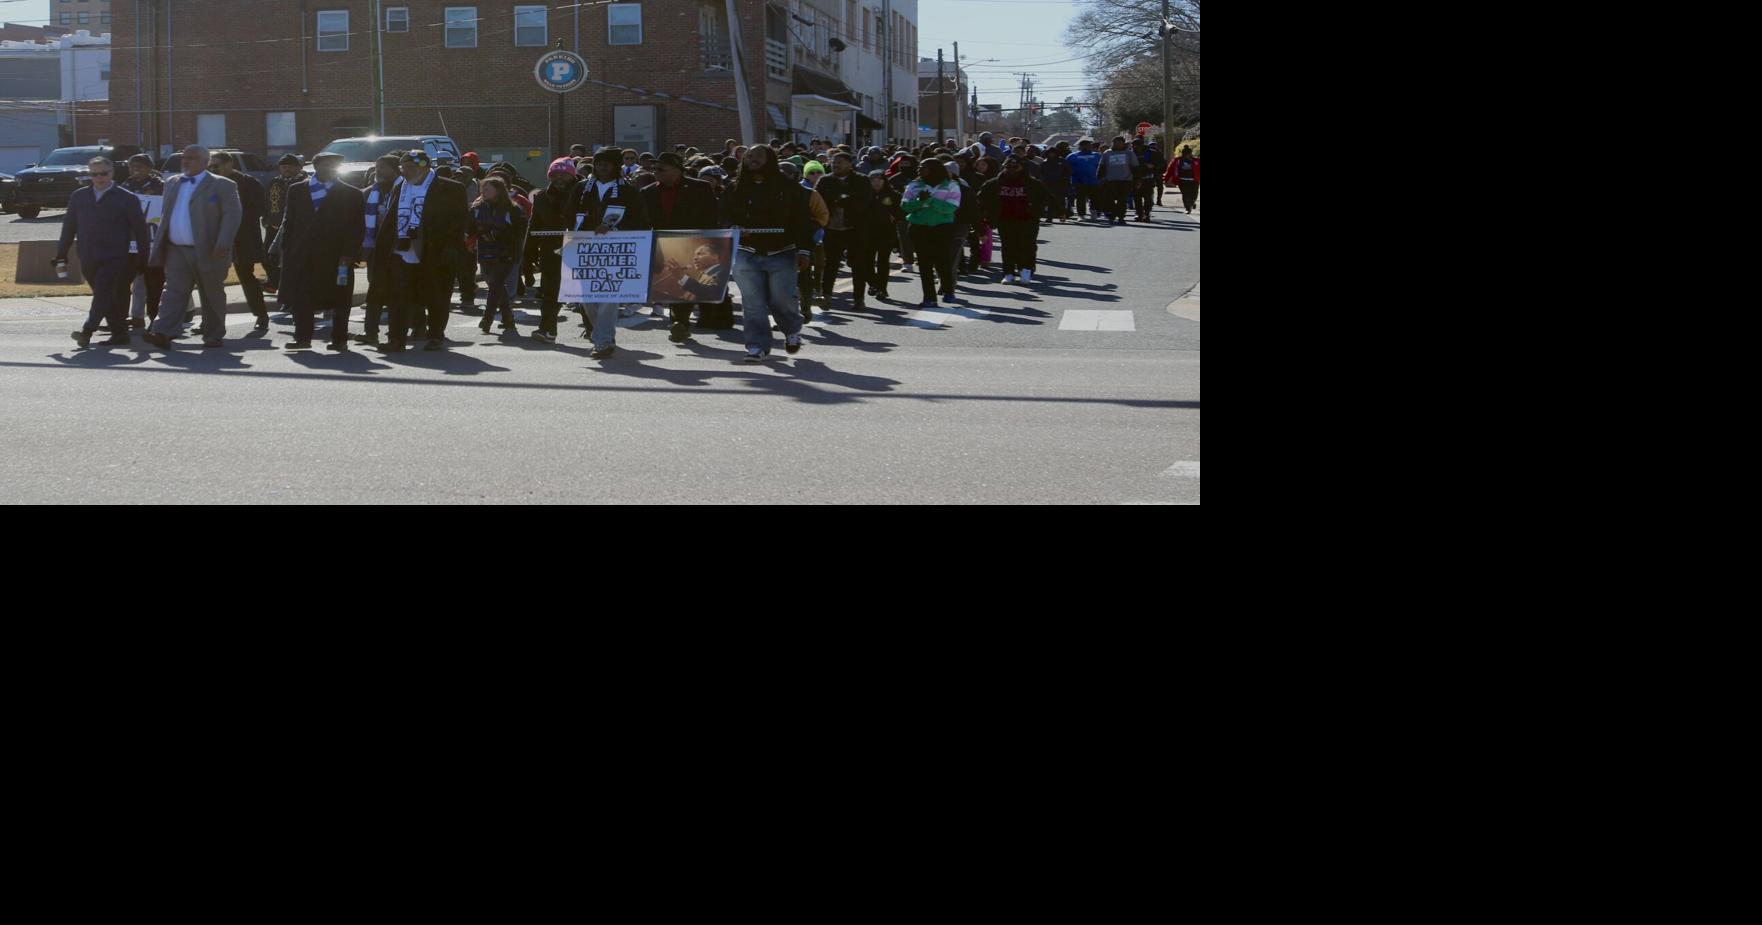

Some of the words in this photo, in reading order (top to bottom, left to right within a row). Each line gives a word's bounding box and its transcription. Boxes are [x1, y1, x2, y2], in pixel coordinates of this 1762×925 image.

[551, 62, 570, 81] P
[577, 242, 636, 254] MARTIN
[578, 254, 637, 266] LUTHER
[572, 267, 614, 281] KING,
[616, 267, 641, 280] JR.
[590, 280, 623, 292] DAY
